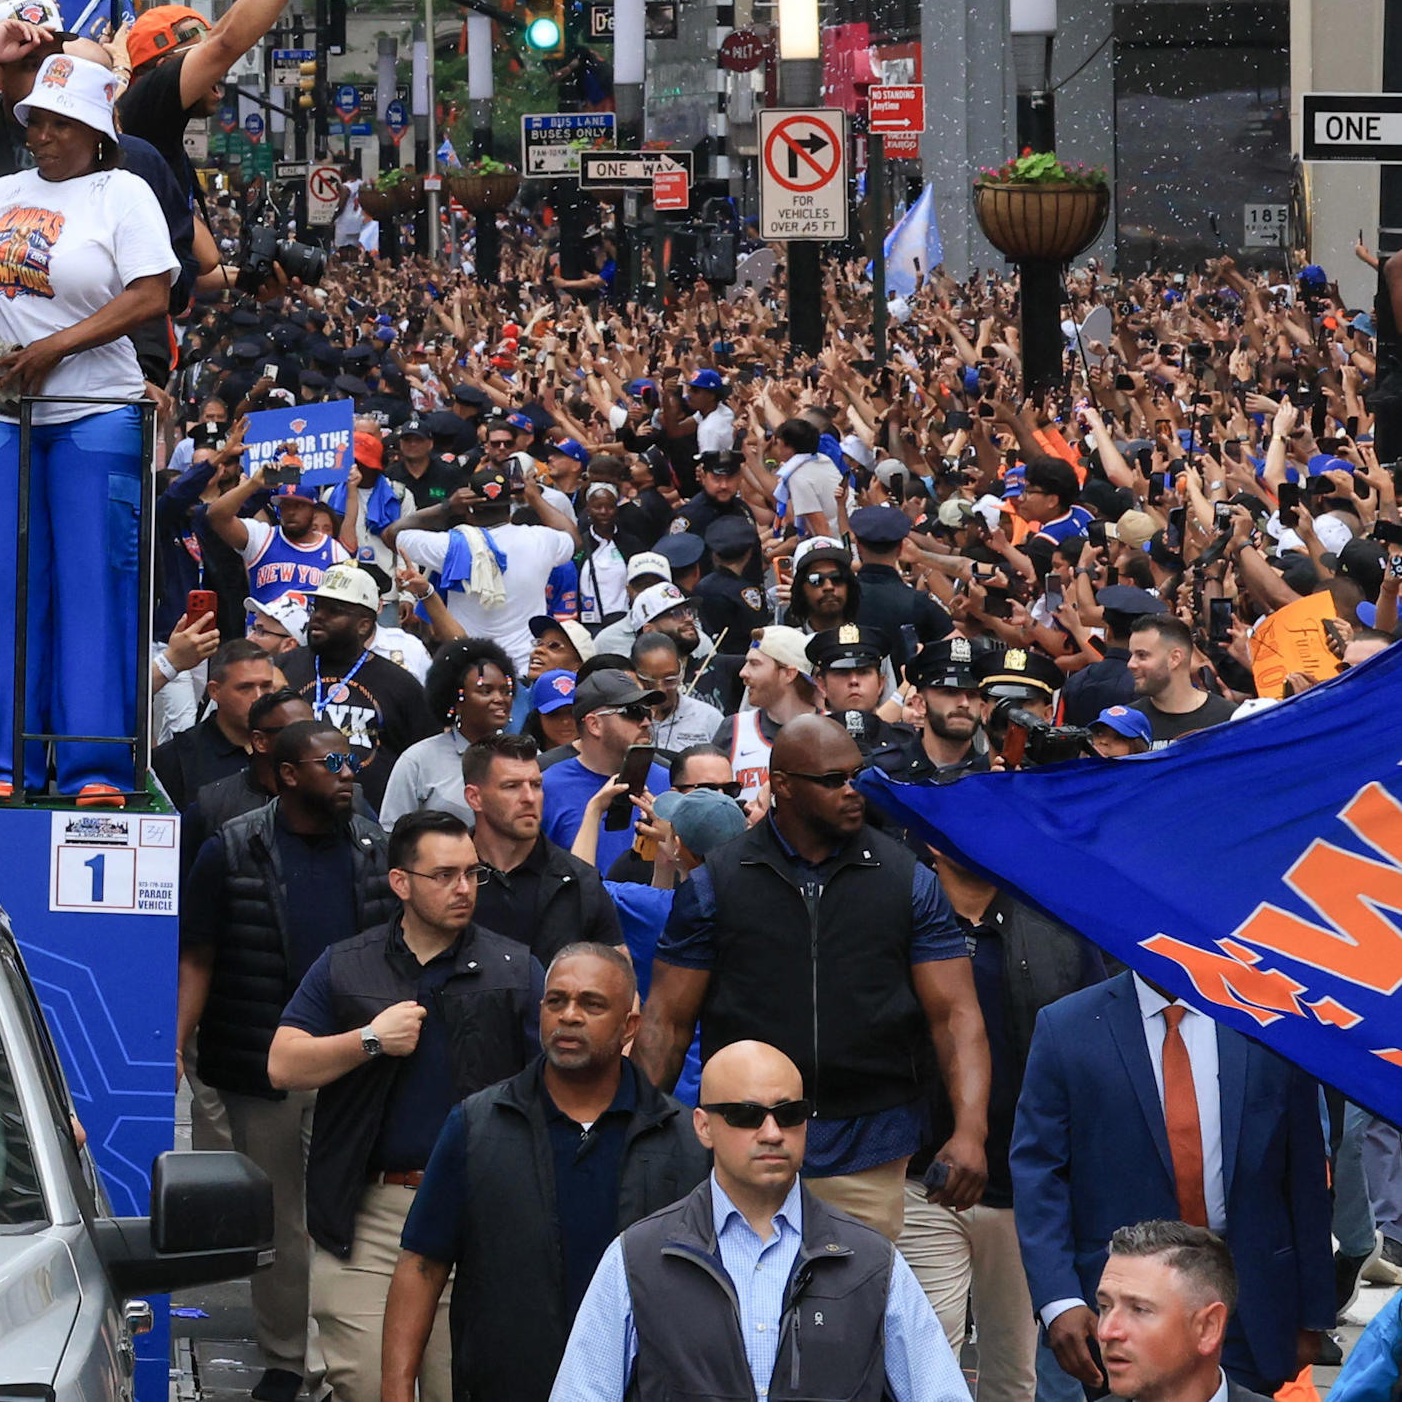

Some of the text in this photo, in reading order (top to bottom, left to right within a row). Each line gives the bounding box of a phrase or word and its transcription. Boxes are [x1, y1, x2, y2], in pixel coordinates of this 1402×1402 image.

[872, 90, 915, 99] NO STANDING
[872, 101, 899, 111] Anytime
[551, 117, 605, 127] BUS LANE
[531, 128, 607, 139] BUSES ONLY
[1326, 116, 1381, 141] ONE
[597, 163, 627, 176] ONE
[793, 196, 814, 205] FOR
[778, 209, 829, 219] VEHICLES
[1251, 209, 1287, 223] 185
[771, 222, 799, 232] OVER
[823, 222, 836, 231] FT
[320, 430, 349, 450] THE
[257, 562, 296, 588] NEW
[84, 854, 105, 902] 1
[139, 889, 172, 899] PARADE
[138, 900, 173, 910] VEHICLE
